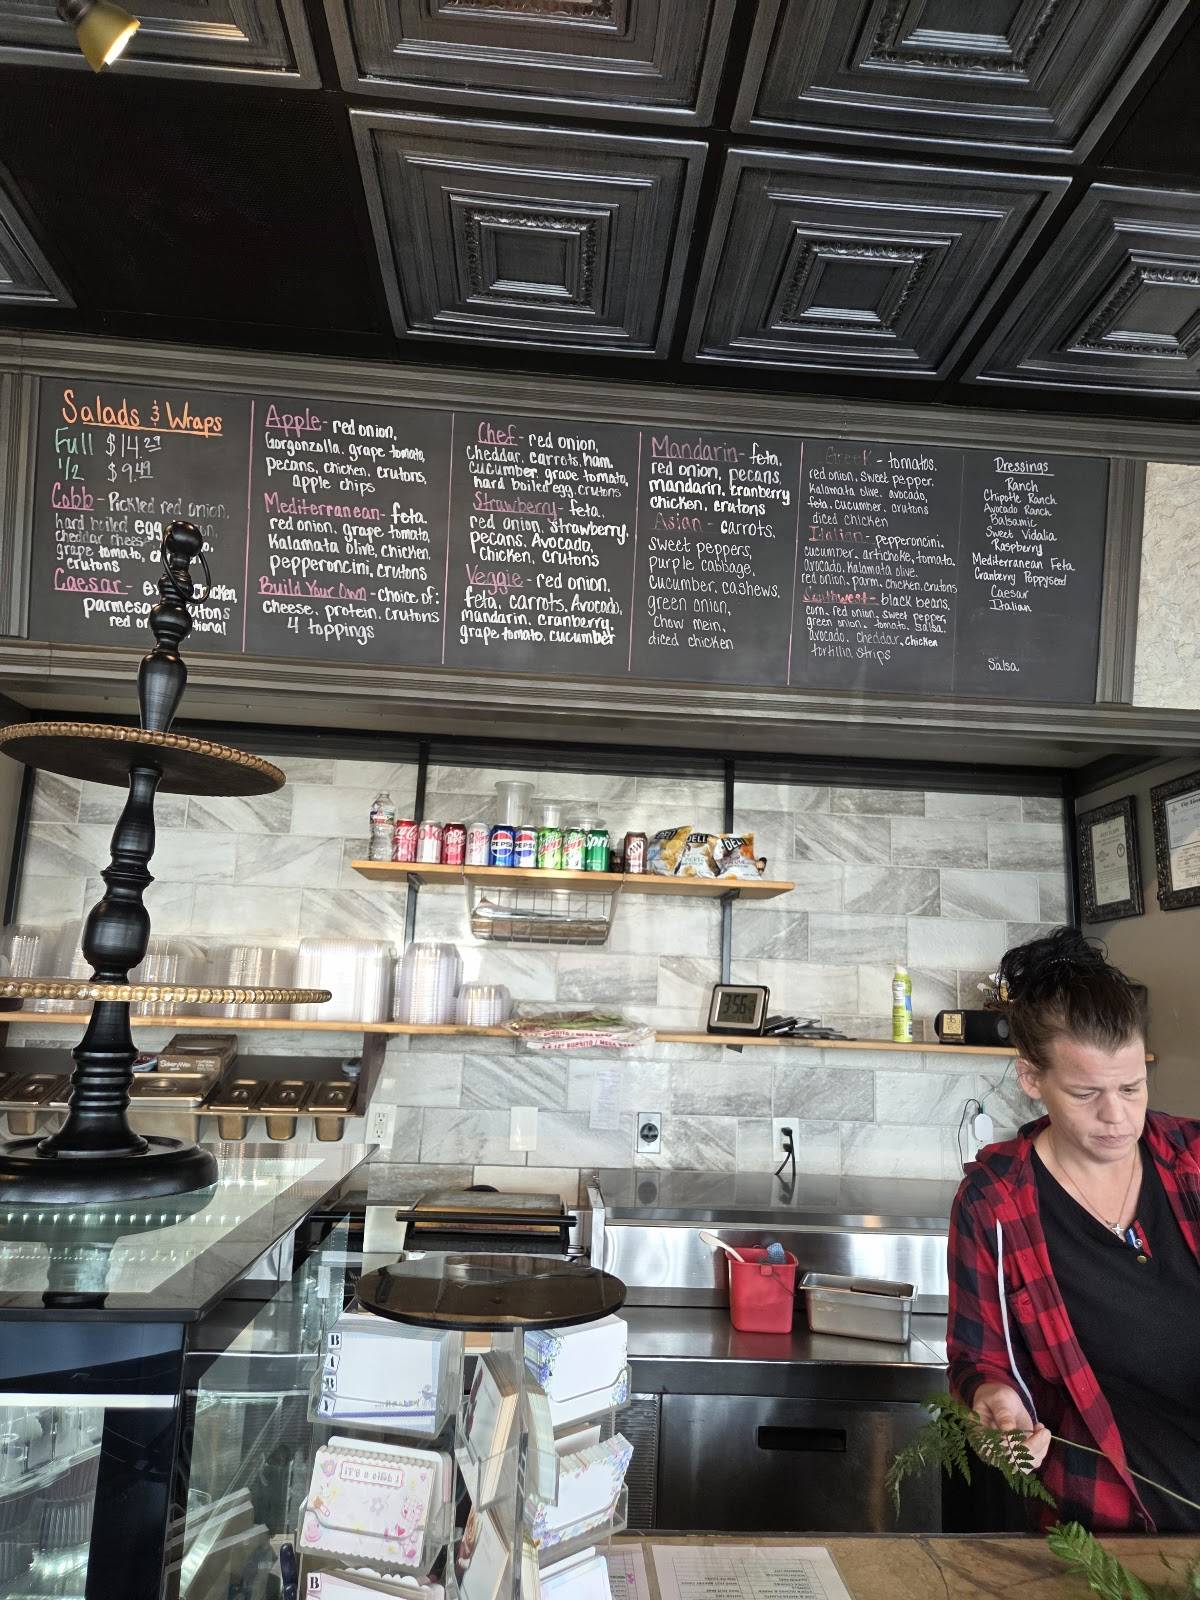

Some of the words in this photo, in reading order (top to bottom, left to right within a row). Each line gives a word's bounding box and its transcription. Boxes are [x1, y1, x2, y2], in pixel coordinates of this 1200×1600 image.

[62, 389, 140, 426] Salads
[166, 402, 222, 438] Wraps
[333, 419, 355, 435] red
[55, 428, 93, 456] Full
[529, 432, 552, 449] red
[349, 444, 385, 462] grape
[58, 458, 84, 481] 1/2
[652, 462, 673, 475] red
[809, 467, 825, 480] red
[993, 457, 1049, 474] Dressings
[545, 468, 579, 484] grape
[1005, 477, 1039, 492] Ranch
[293, 475, 331, 493] apple
[340, 478, 375, 496] chips
[474, 476, 505, 490] hard
[512, 478, 550, 492] boiled
[578, 485, 621, 498] crutons
[730, 485, 790, 505] cranberry
[984, 489, 1021, 504] Chipotle
[1028, 492, 1057, 505] Ranch
[161, 498, 181, 515] red
[713, 499, 765, 516] crutons
[984, 503, 1017, 514] Avocado
[1024, 505, 1052, 516] Ranch
[55, 513, 84, 530] hard
[470, 514, 495, 529] red
[651, 512, 702, 530] Asian
[813, 512, 837, 524] diced
[844, 514, 888, 527] chicken
[990, 514, 1037, 528] Balsamic
[270, 517, 293, 531] red
[343, 525, 384, 544] grape
[986, 526, 1013, 539] Sweet
[1022, 528, 1057, 542] Vidalia
[57, 543, 93, 563] grape
[268, 534, 340, 554] Kalamata
[347, 540, 377, 558] olive,
[649, 537, 691, 552] sweet
[697, 543, 752, 559] peppers,
[991, 539, 1043, 556] Raspberry
[67, 558, 120, 572] crutons
[542, 550, 599, 568] crutons
[650, 556, 694, 573] purple
[972, 552, 1043, 569] Mediterranean
[1051, 557, 1075, 571] Feta
[377, 563, 427, 580] crutons
[802, 573, 816, 584] red
[974, 567, 1015, 586] Cranberry
[258, 575, 300, 595] Build
[306, 581, 333, 598] Your
[339, 583, 366, 600] Own
[536, 573, 562, 588] red
[881, 593, 912, 607] black
[991, 584, 1029, 599] Caesar
[648, 596, 686, 616] green
[833, 605, 848, 617] red
[882, 610, 907, 619] sweet
[989, 599, 1032, 612] Italian
[110, 616, 130, 628] red
[807, 617, 832, 631] green
[287, 617, 299, 634] 4
[308, 619, 374, 645] toppings
[460, 625, 499, 645] grape
[550, 630, 615, 645] cucumber
[648, 633, 679, 646] diced
[688, 634, 733, 649] chicken
[905, 637, 938, 647] chicken
[857, 648, 891, 666] strips
[988, 657, 1019, 672] Salsa
